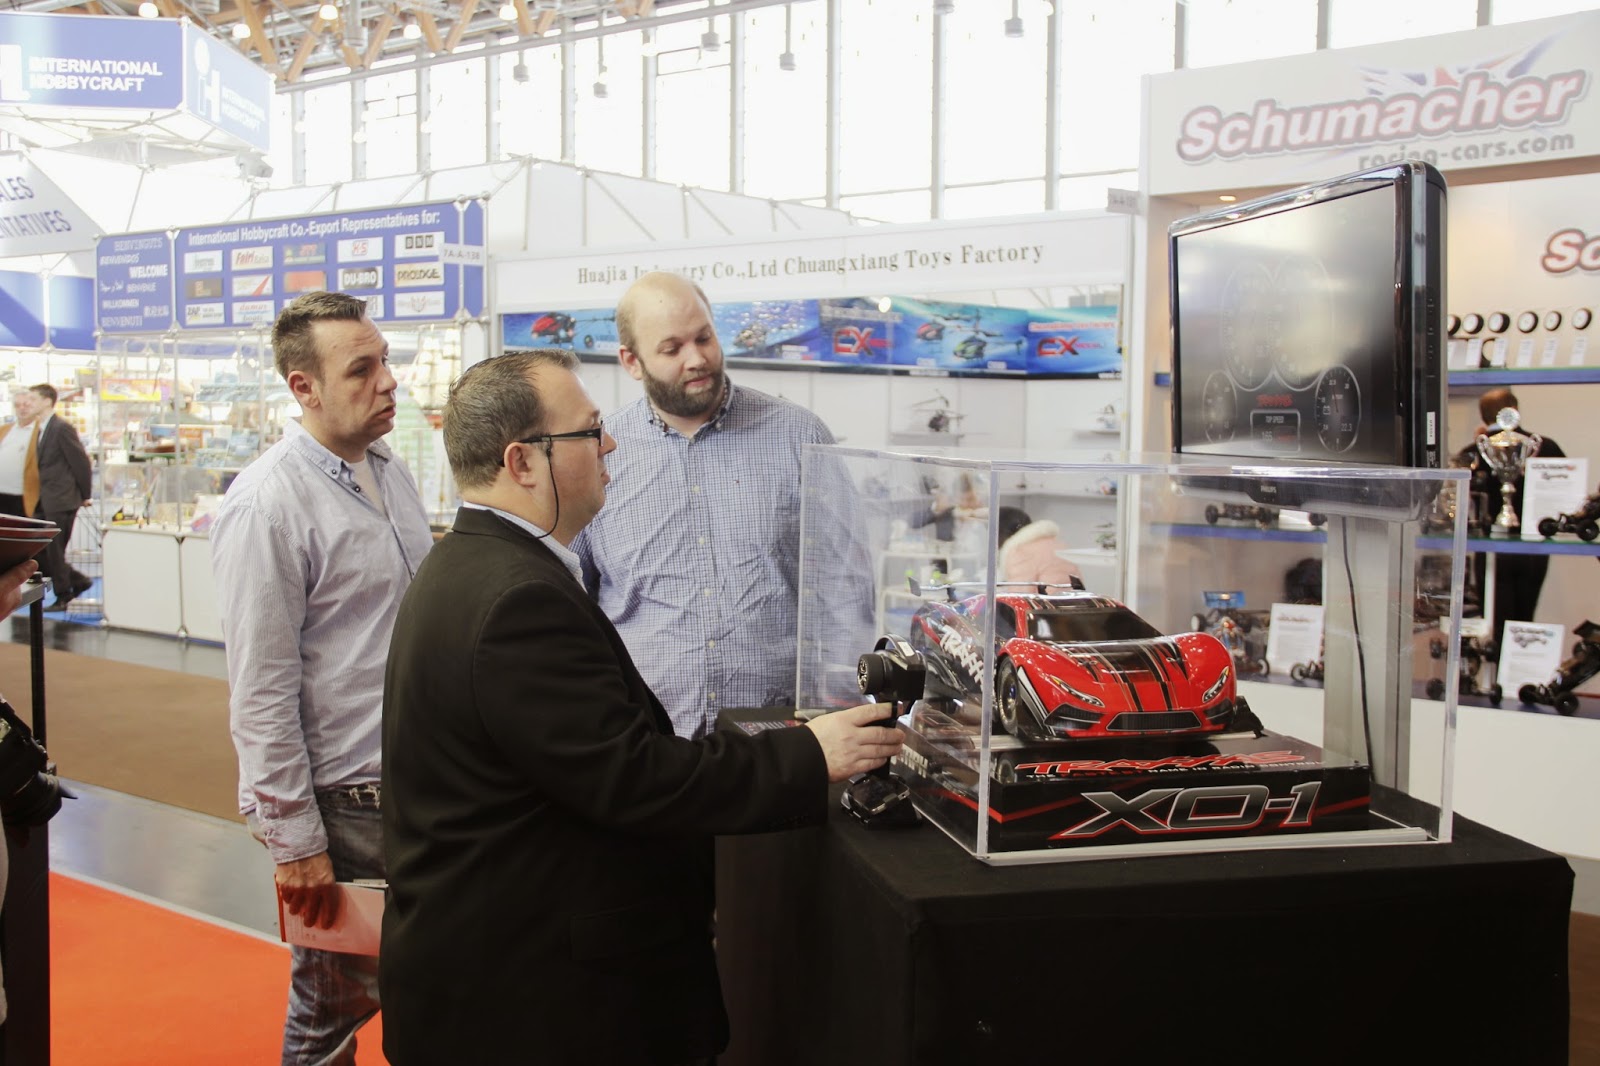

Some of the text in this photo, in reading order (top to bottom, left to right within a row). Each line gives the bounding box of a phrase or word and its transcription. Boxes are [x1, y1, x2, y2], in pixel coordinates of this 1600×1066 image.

[29, 56, 162, 76] INTERNATIONAL
[29, 73, 145, 91] HOBBYCRAFT
[1176, 69, 1589, 161] Schumacher
[188, 229, 240, 246] International
[240, 223, 289, 242] Hobbycraft
[341, 213, 420, 234] Representatives
[421, 209, 441, 225] for:
[129, 264, 168, 279] WELCOME
[343, 270, 377, 285] DU-BRO
[578, 265, 627, 285] Huajia
[634, 262, 707, 281] Itry
[784, 252, 899, 276] Chuangxiang
[904, 248, 952, 268] Toys
[960, 243, 1044, 264] Factory
[1048, 781, 1322, 840] XO-1
